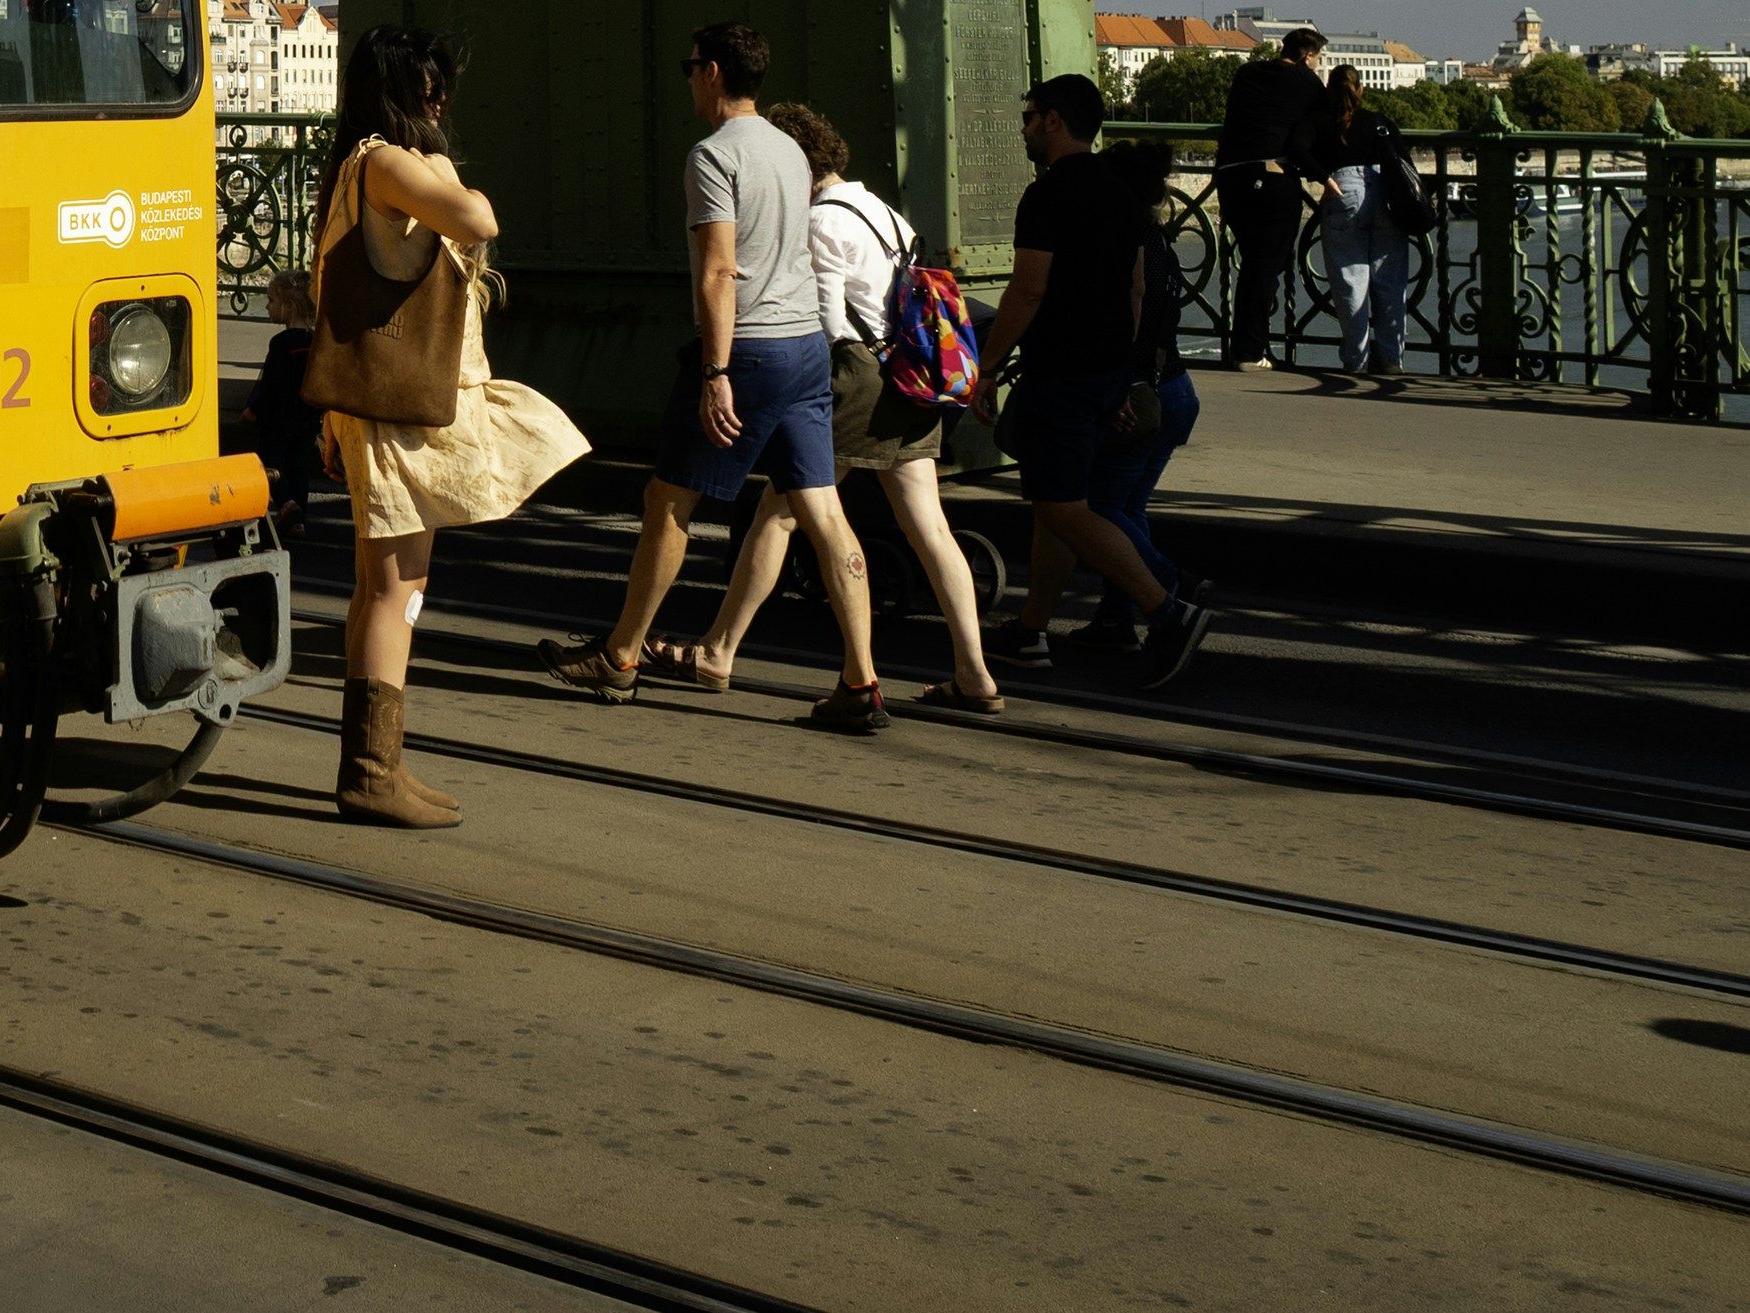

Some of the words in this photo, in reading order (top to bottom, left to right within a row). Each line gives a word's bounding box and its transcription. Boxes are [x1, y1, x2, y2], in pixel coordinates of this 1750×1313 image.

[141, 190, 192, 206] BUDAPESTI
[70, 212, 101, 231] BKK
[141, 205, 202, 224] KÖZLEKEDÉSI
[141, 225, 185, 242] KÖZPONT
